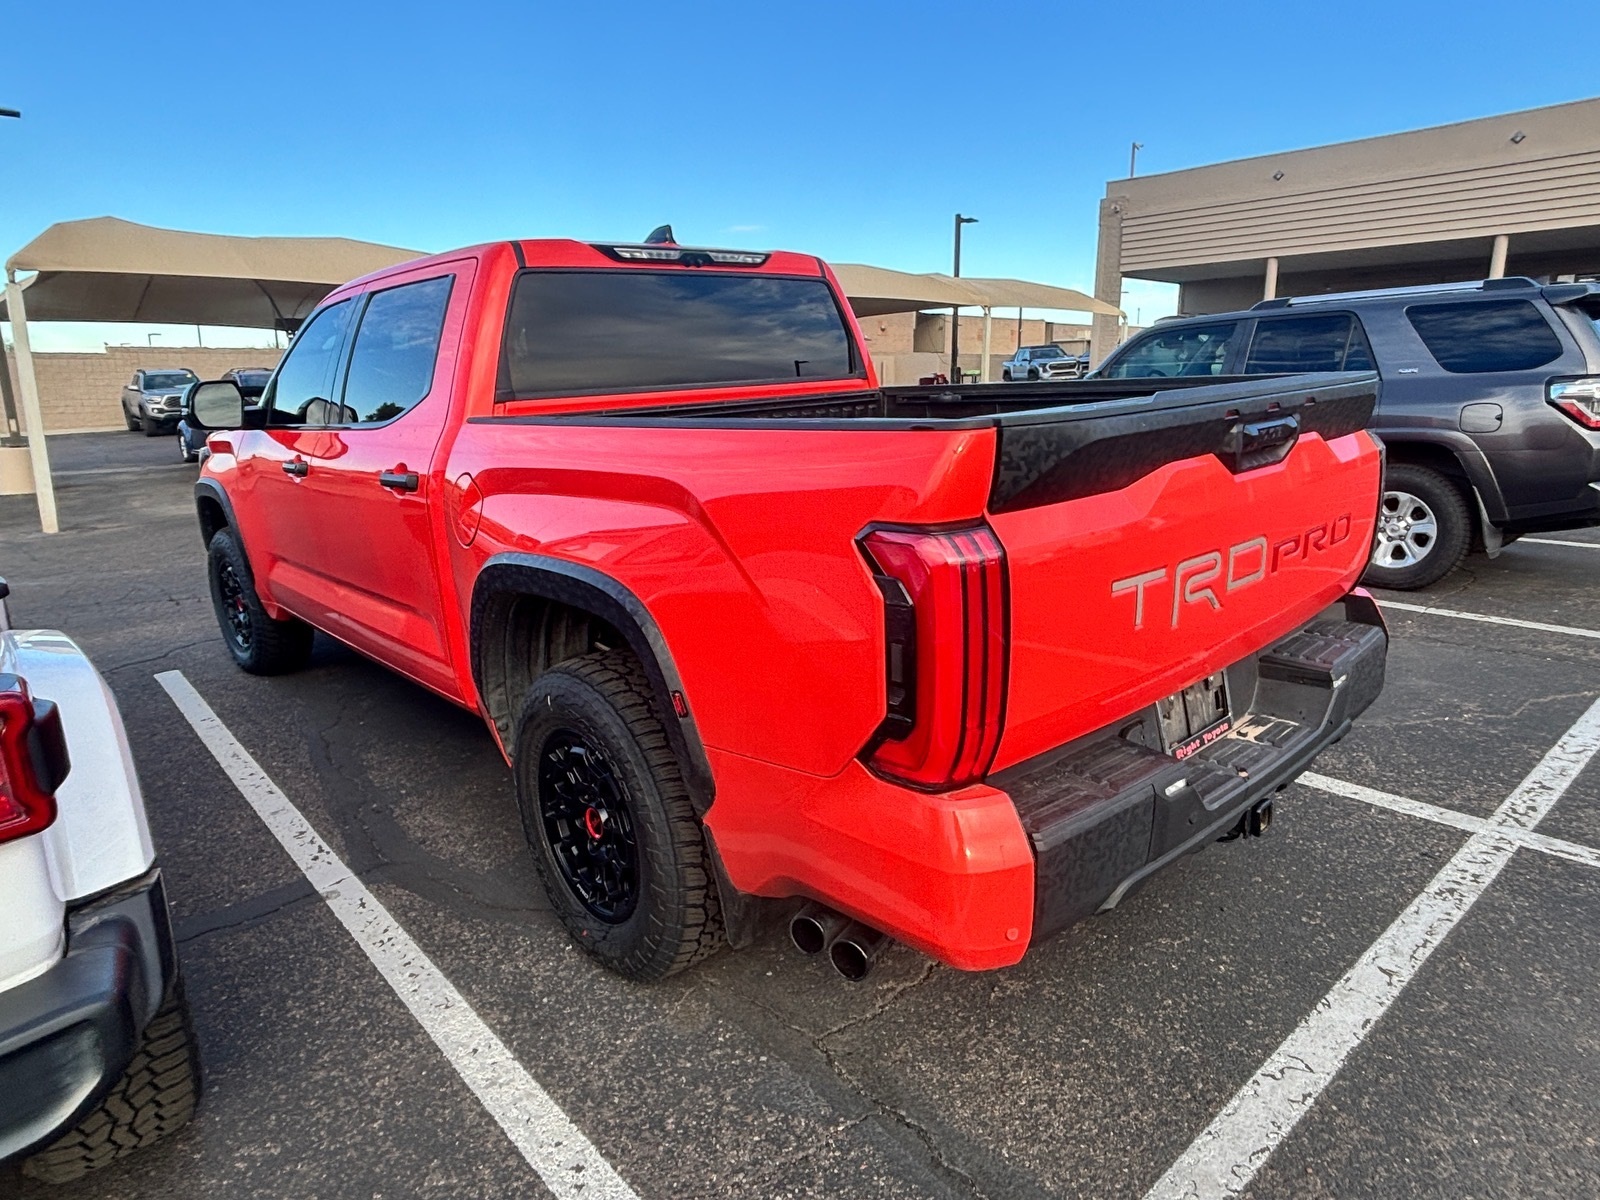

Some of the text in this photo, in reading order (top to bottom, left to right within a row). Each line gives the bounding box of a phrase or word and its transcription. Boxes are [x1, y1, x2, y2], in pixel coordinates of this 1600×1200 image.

[1111, 514, 1350, 627] TRD PRO
[1176, 723, 1229, 759] Right Toyota
